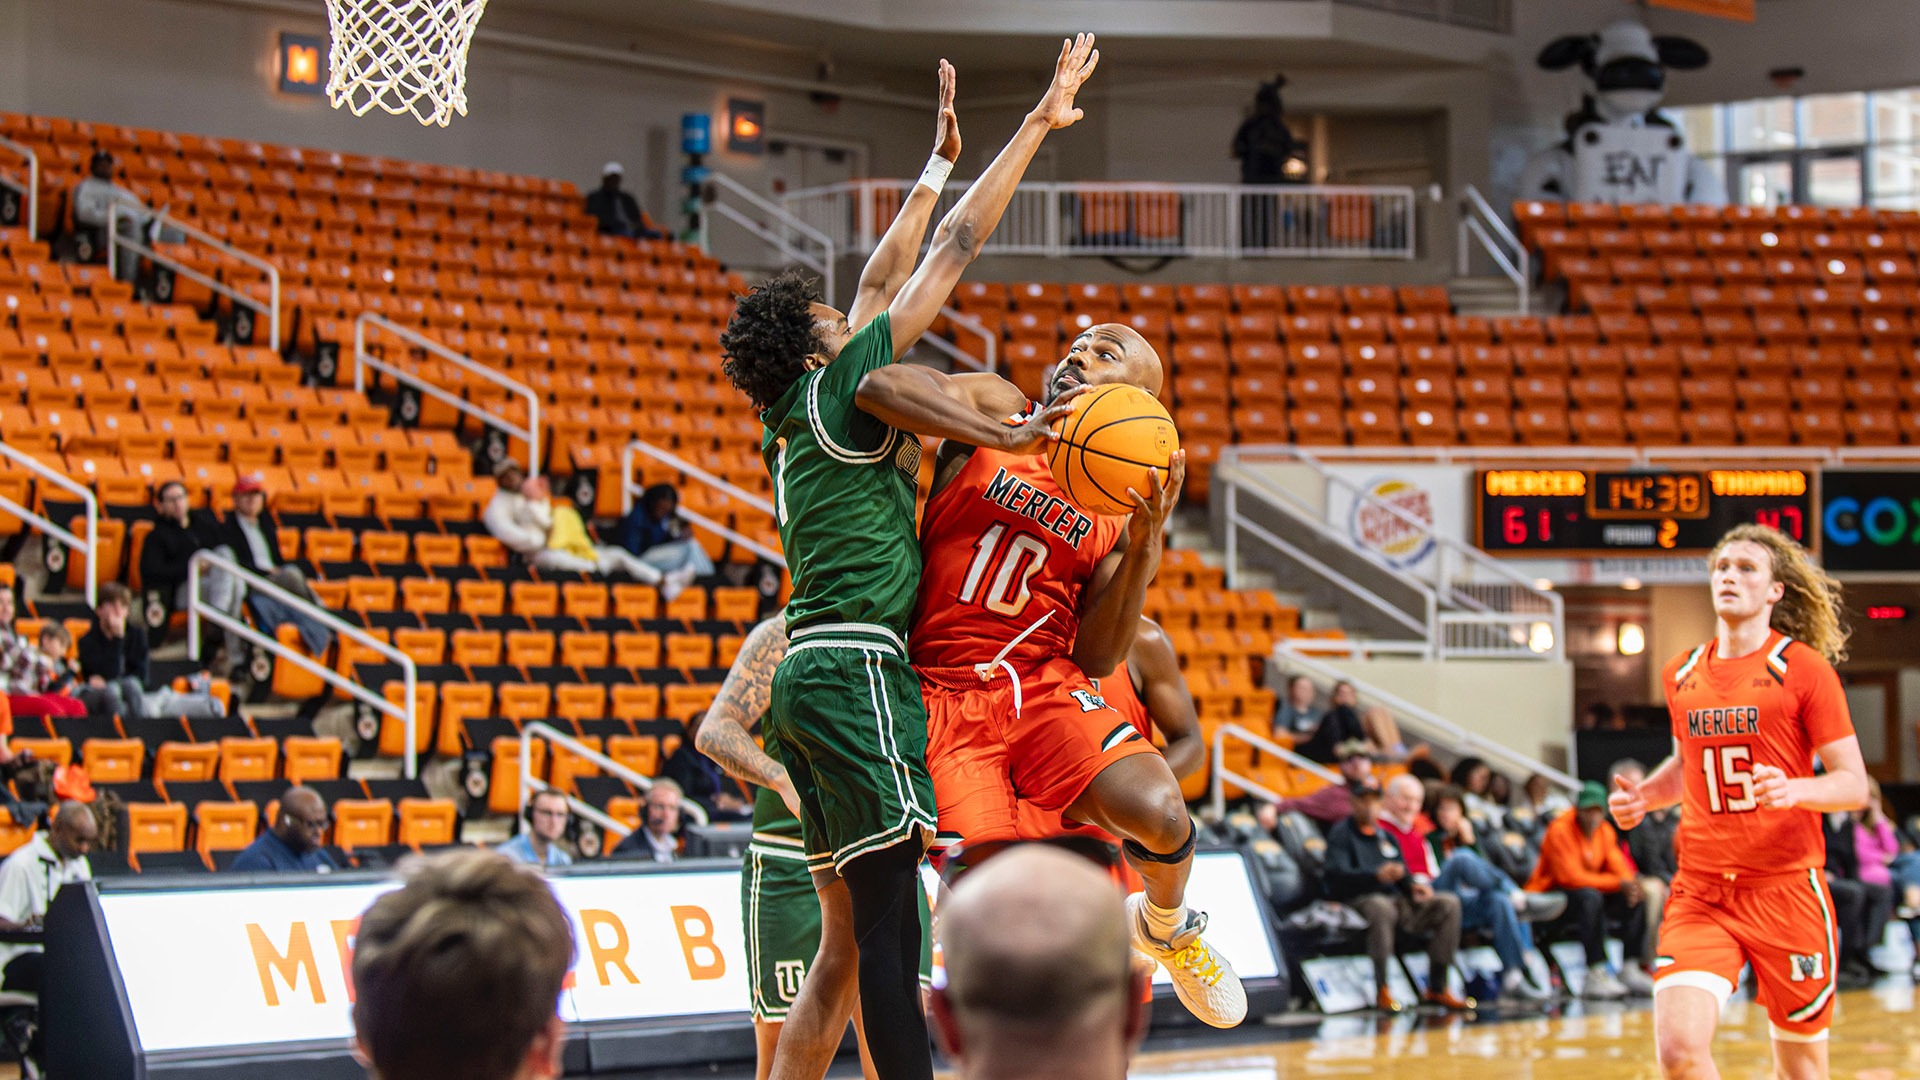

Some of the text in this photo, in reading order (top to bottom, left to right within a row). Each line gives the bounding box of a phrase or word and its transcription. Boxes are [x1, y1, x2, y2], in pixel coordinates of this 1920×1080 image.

[982, 466, 1093, 550] MERCER
[1608, 475, 1700, 513] 14:38
[1657, 518, 1679, 549] 2
[1823, 496, 1920, 546] CO
[956, 520, 1051, 619] 10
[1687, 706, 1760, 737] MERCER
[1702, 744, 1759, 815] 15
